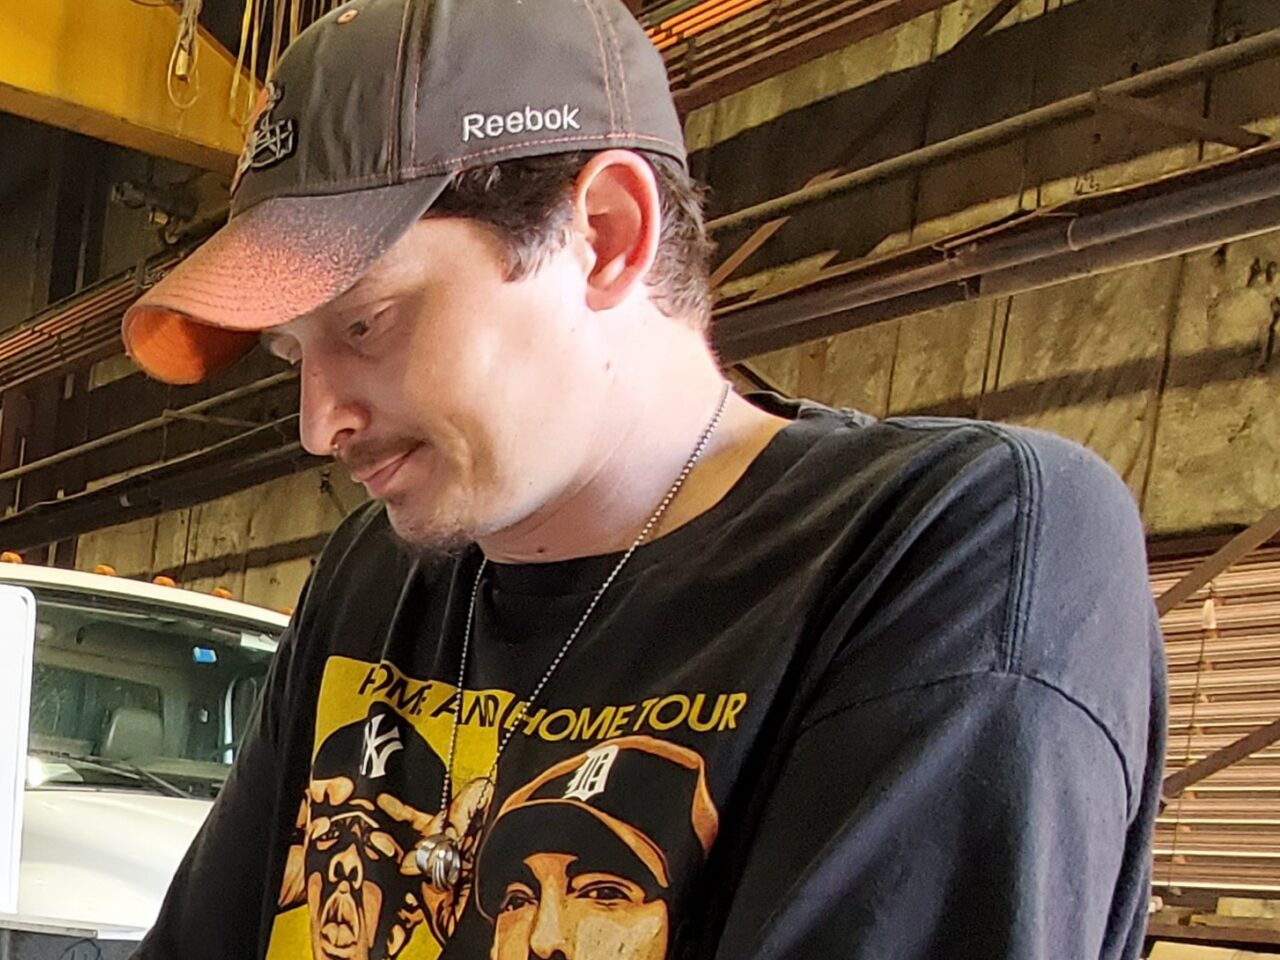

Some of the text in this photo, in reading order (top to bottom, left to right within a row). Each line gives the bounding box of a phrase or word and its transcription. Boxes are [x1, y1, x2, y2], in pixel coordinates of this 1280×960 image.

[462, 103, 581, 142] Reebok
[430, 692, 500, 728] AND
[503, 701, 637, 742] HOME
[632, 692, 748, 732] TOUR
